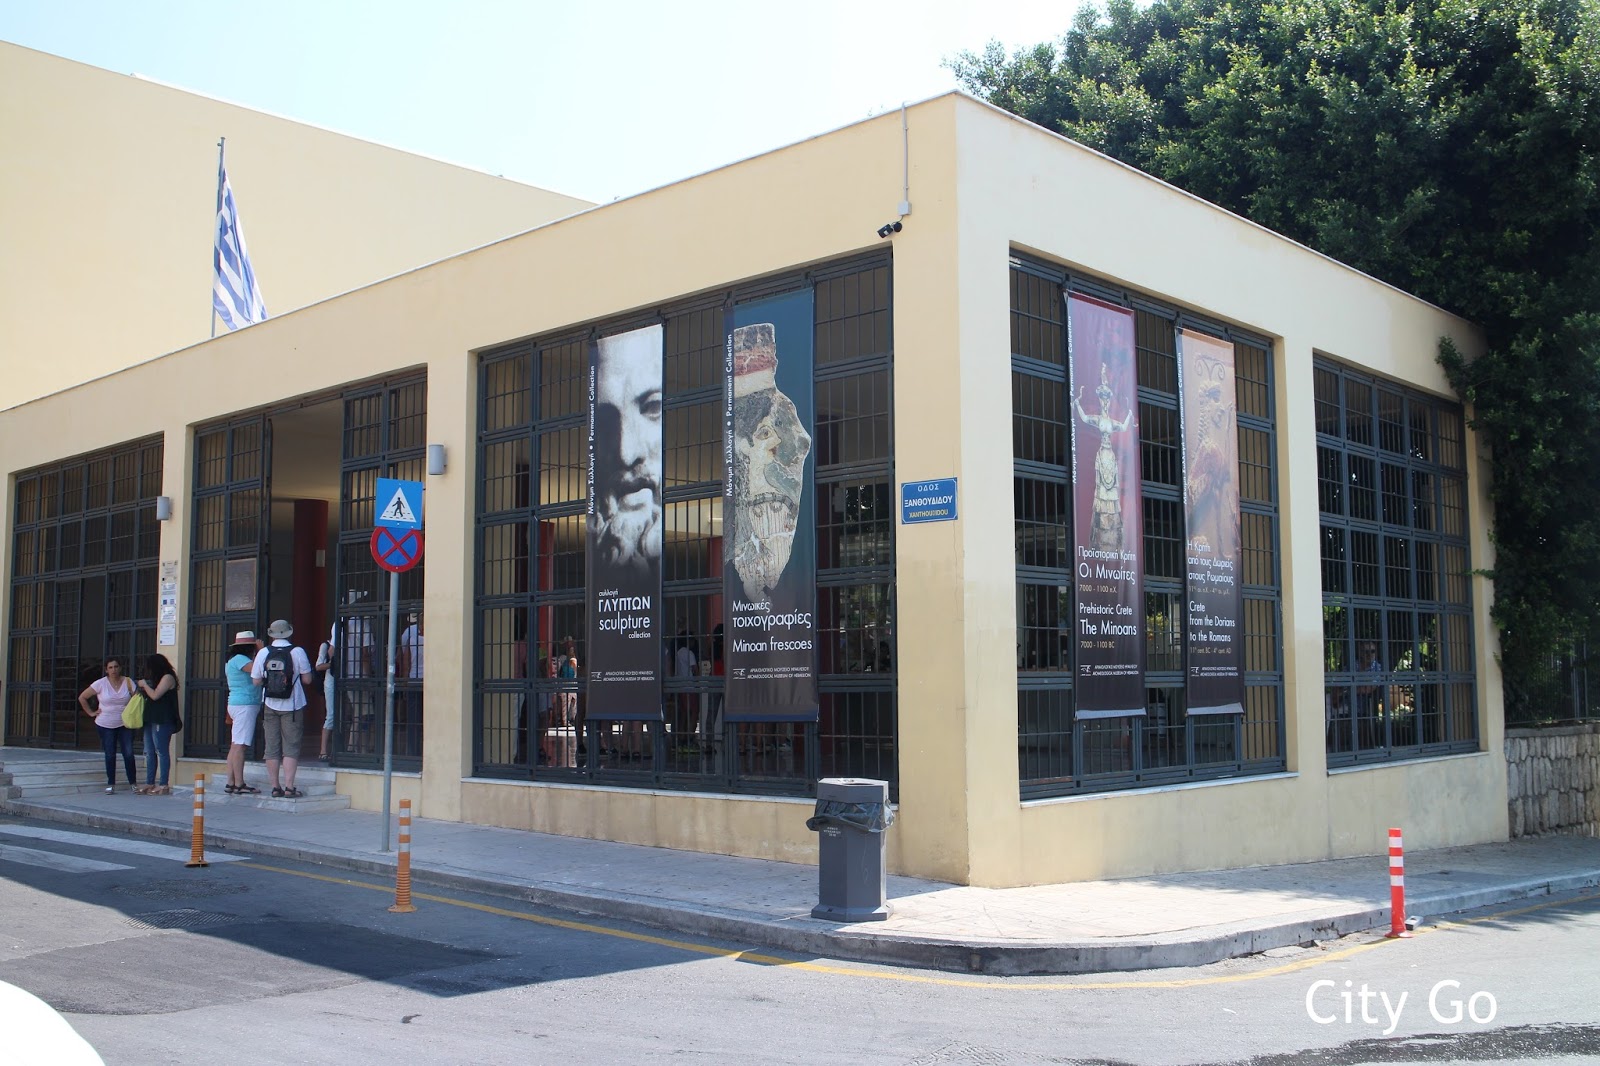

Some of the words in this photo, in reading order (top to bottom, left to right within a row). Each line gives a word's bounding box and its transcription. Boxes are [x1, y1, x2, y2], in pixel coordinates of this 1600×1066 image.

[726, 429, 734, 464] Συλλογή
[917, 483, 939, 492] ΟΔΟΣ
[904, 495, 953, 508] ΞΑΝΘΟΥΔΙΔΟΥ
[1079, 562, 1092, 578] Οι
[1096, 563, 1136, 585] Μινωίτες
[598, 596, 651, 613] ΓΛΥΠΤΩΝ
[733, 598, 771, 613] Μινωικές
[1080, 602, 1114, 615] Prehistoric
[1115, 604, 1133, 615] Crete
[1189, 600, 1206, 612] Crete
[599, 611, 651, 635] sculpture
[732, 608, 812, 631] τοιχογραφίες
[1080, 618, 1098, 635] The
[1100, 620, 1137, 636] Minoans
[1189, 613, 1204, 626] from
[1204, 614, 1214, 626] the
[1214, 615, 1236, 627] Dorians
[628, 630, 651, 639] collection
[1189, 631, 1197, 641] to
[1198, 629, 1208, 641] the
[1208, 631, 1232, 642] Romans
[732, 639, 768, 653] Minoan
[770, 636, 812, 651] frescoes
